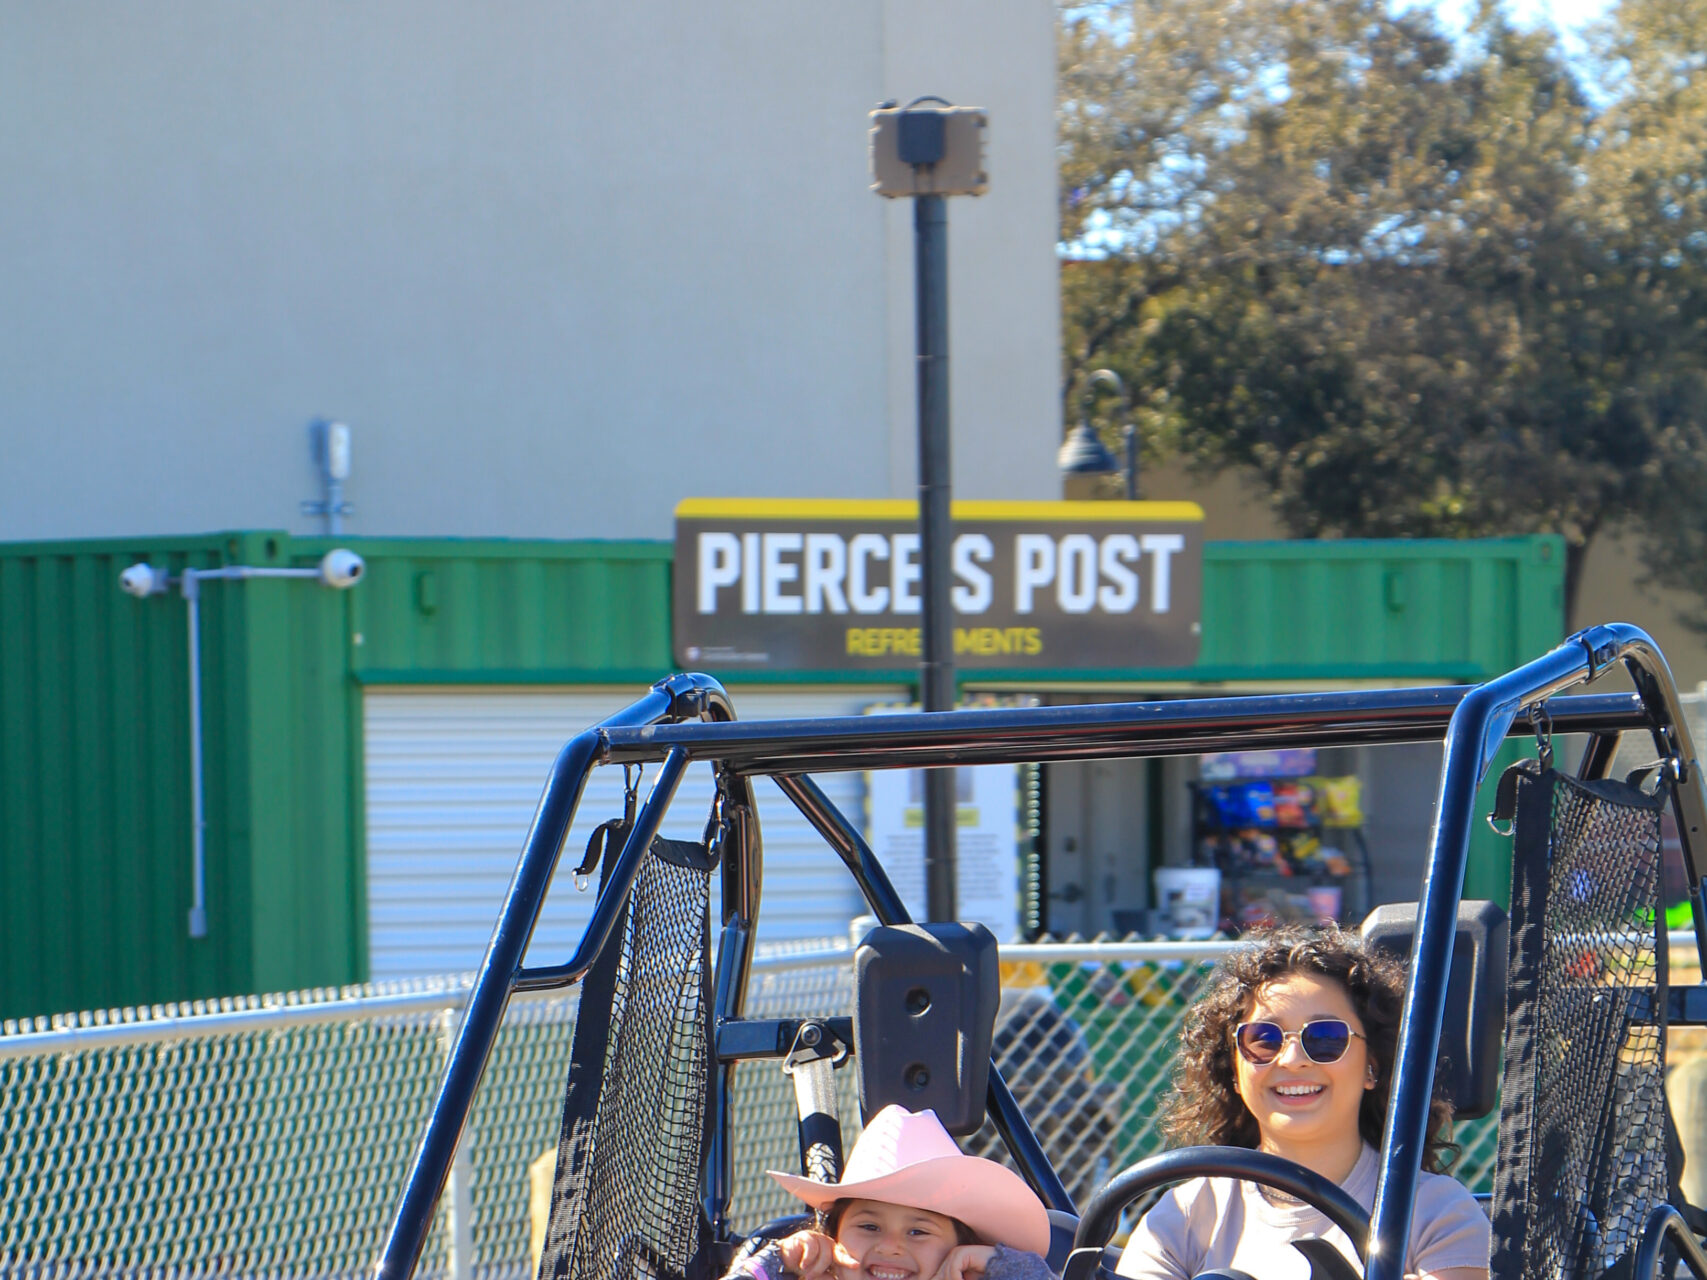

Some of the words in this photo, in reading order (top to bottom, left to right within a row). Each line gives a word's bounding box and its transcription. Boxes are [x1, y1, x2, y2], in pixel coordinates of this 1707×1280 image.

[696, 531, 995, 615] PIERCES
[1013, 533, 1185, 614] POST
[846, 627, 1042, 656] REFREMENTS
